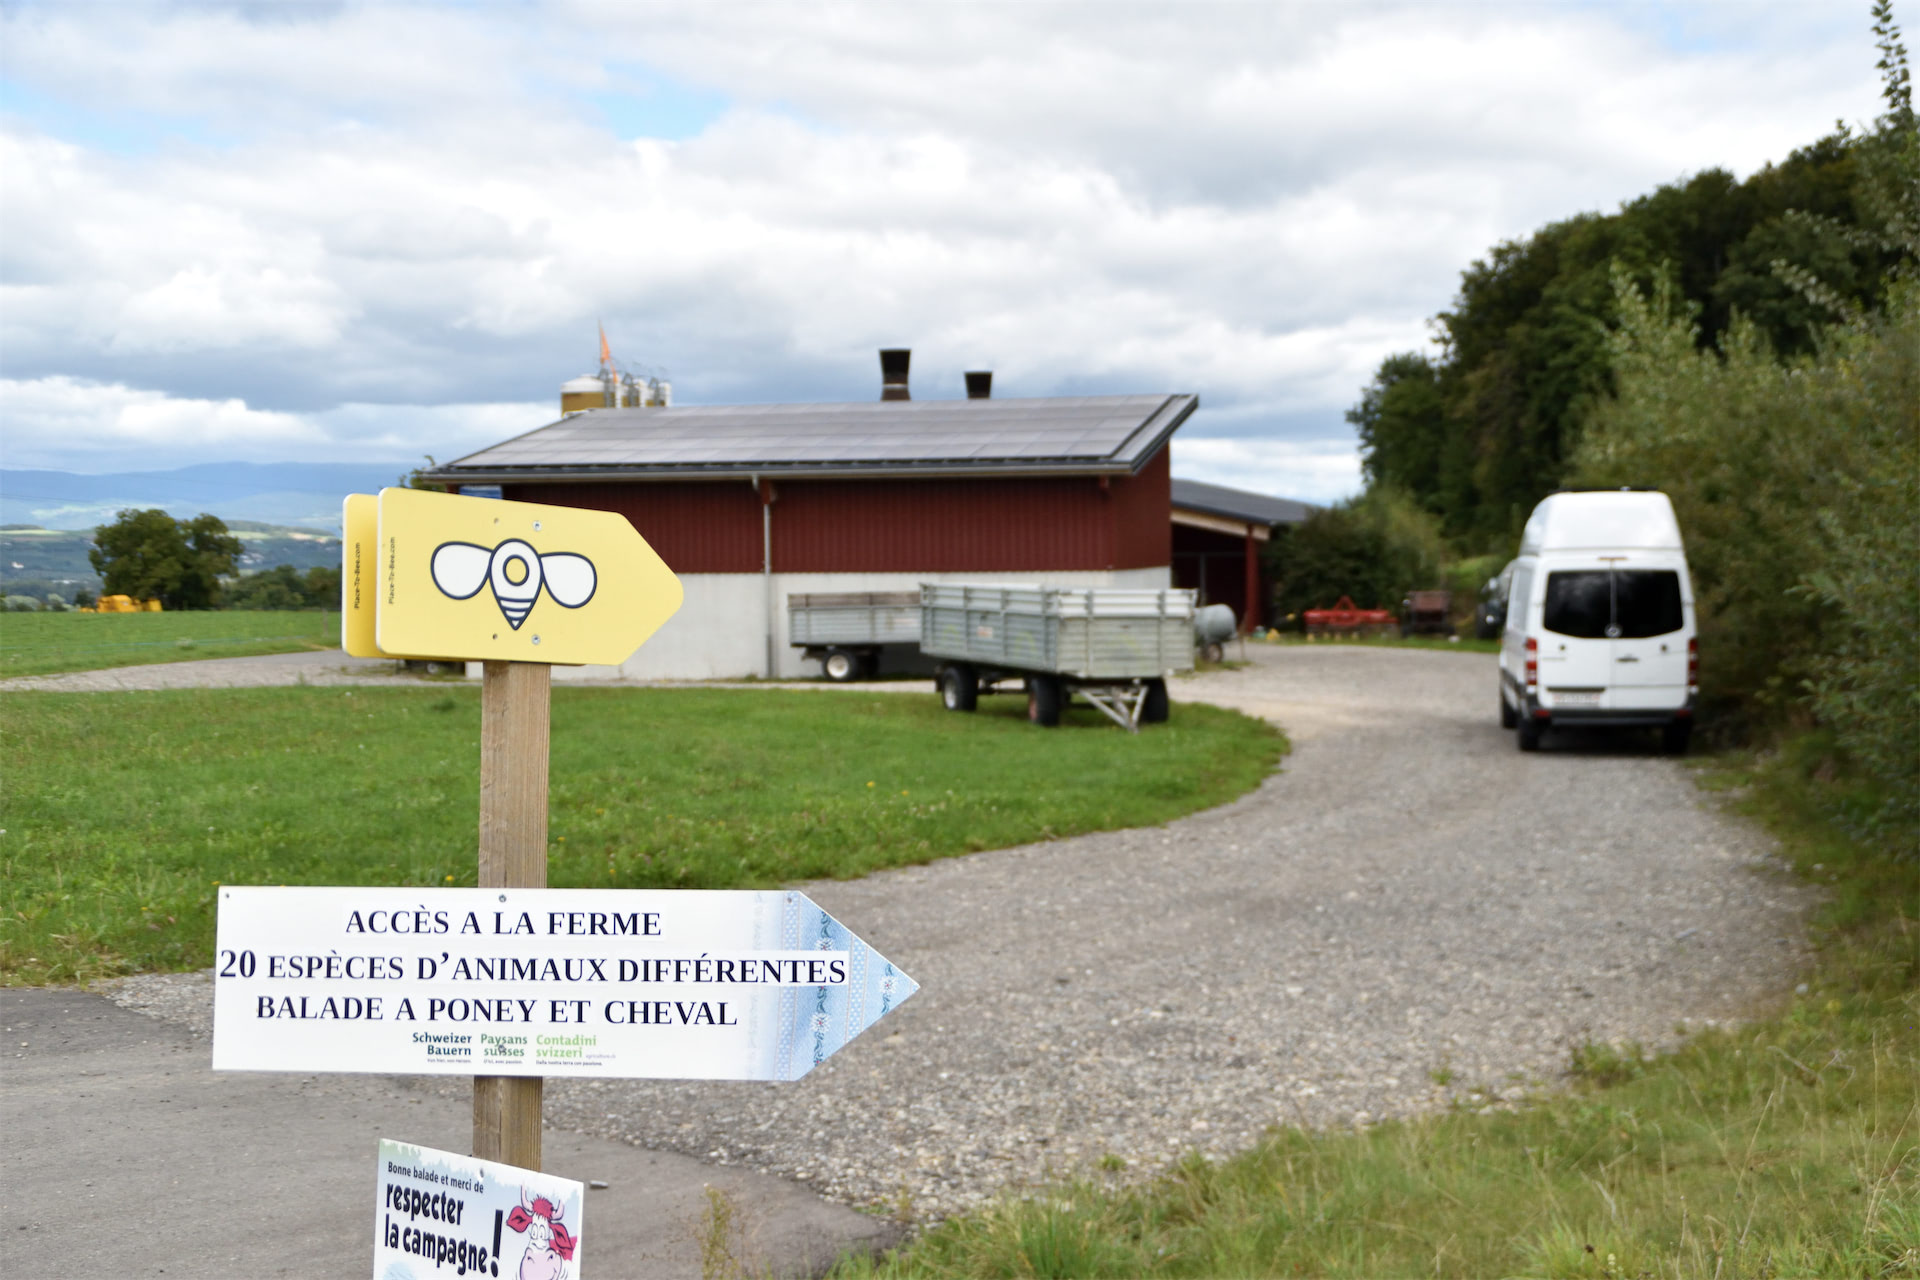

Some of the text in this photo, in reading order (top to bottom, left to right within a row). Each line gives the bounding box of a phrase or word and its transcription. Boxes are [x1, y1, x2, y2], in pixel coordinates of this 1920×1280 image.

[345, 904, 662, 936] ACCÈS A LA FERME
[219, 949, 846, 984] 20 ESPÈCES D’ANIMAUX DIFFÉRENTES
[256, 995, 738, 1026] BALADE A PONEY ET CHEVAL
[412, 1032, 472, 1044] Schweizer
[427, 1045, 471, 1056] Bauern
[480, 1033, 528, 1047] Paysans
[536, 1034, 597, 1046] Contadini
[536, 1047, 583, 1058] svizzeri
[388, 1161, 484, 1193] Bonne balade et merci de
[386, 1183, 464, 1225] respecter
[384, 1213, 399, 1249] la
